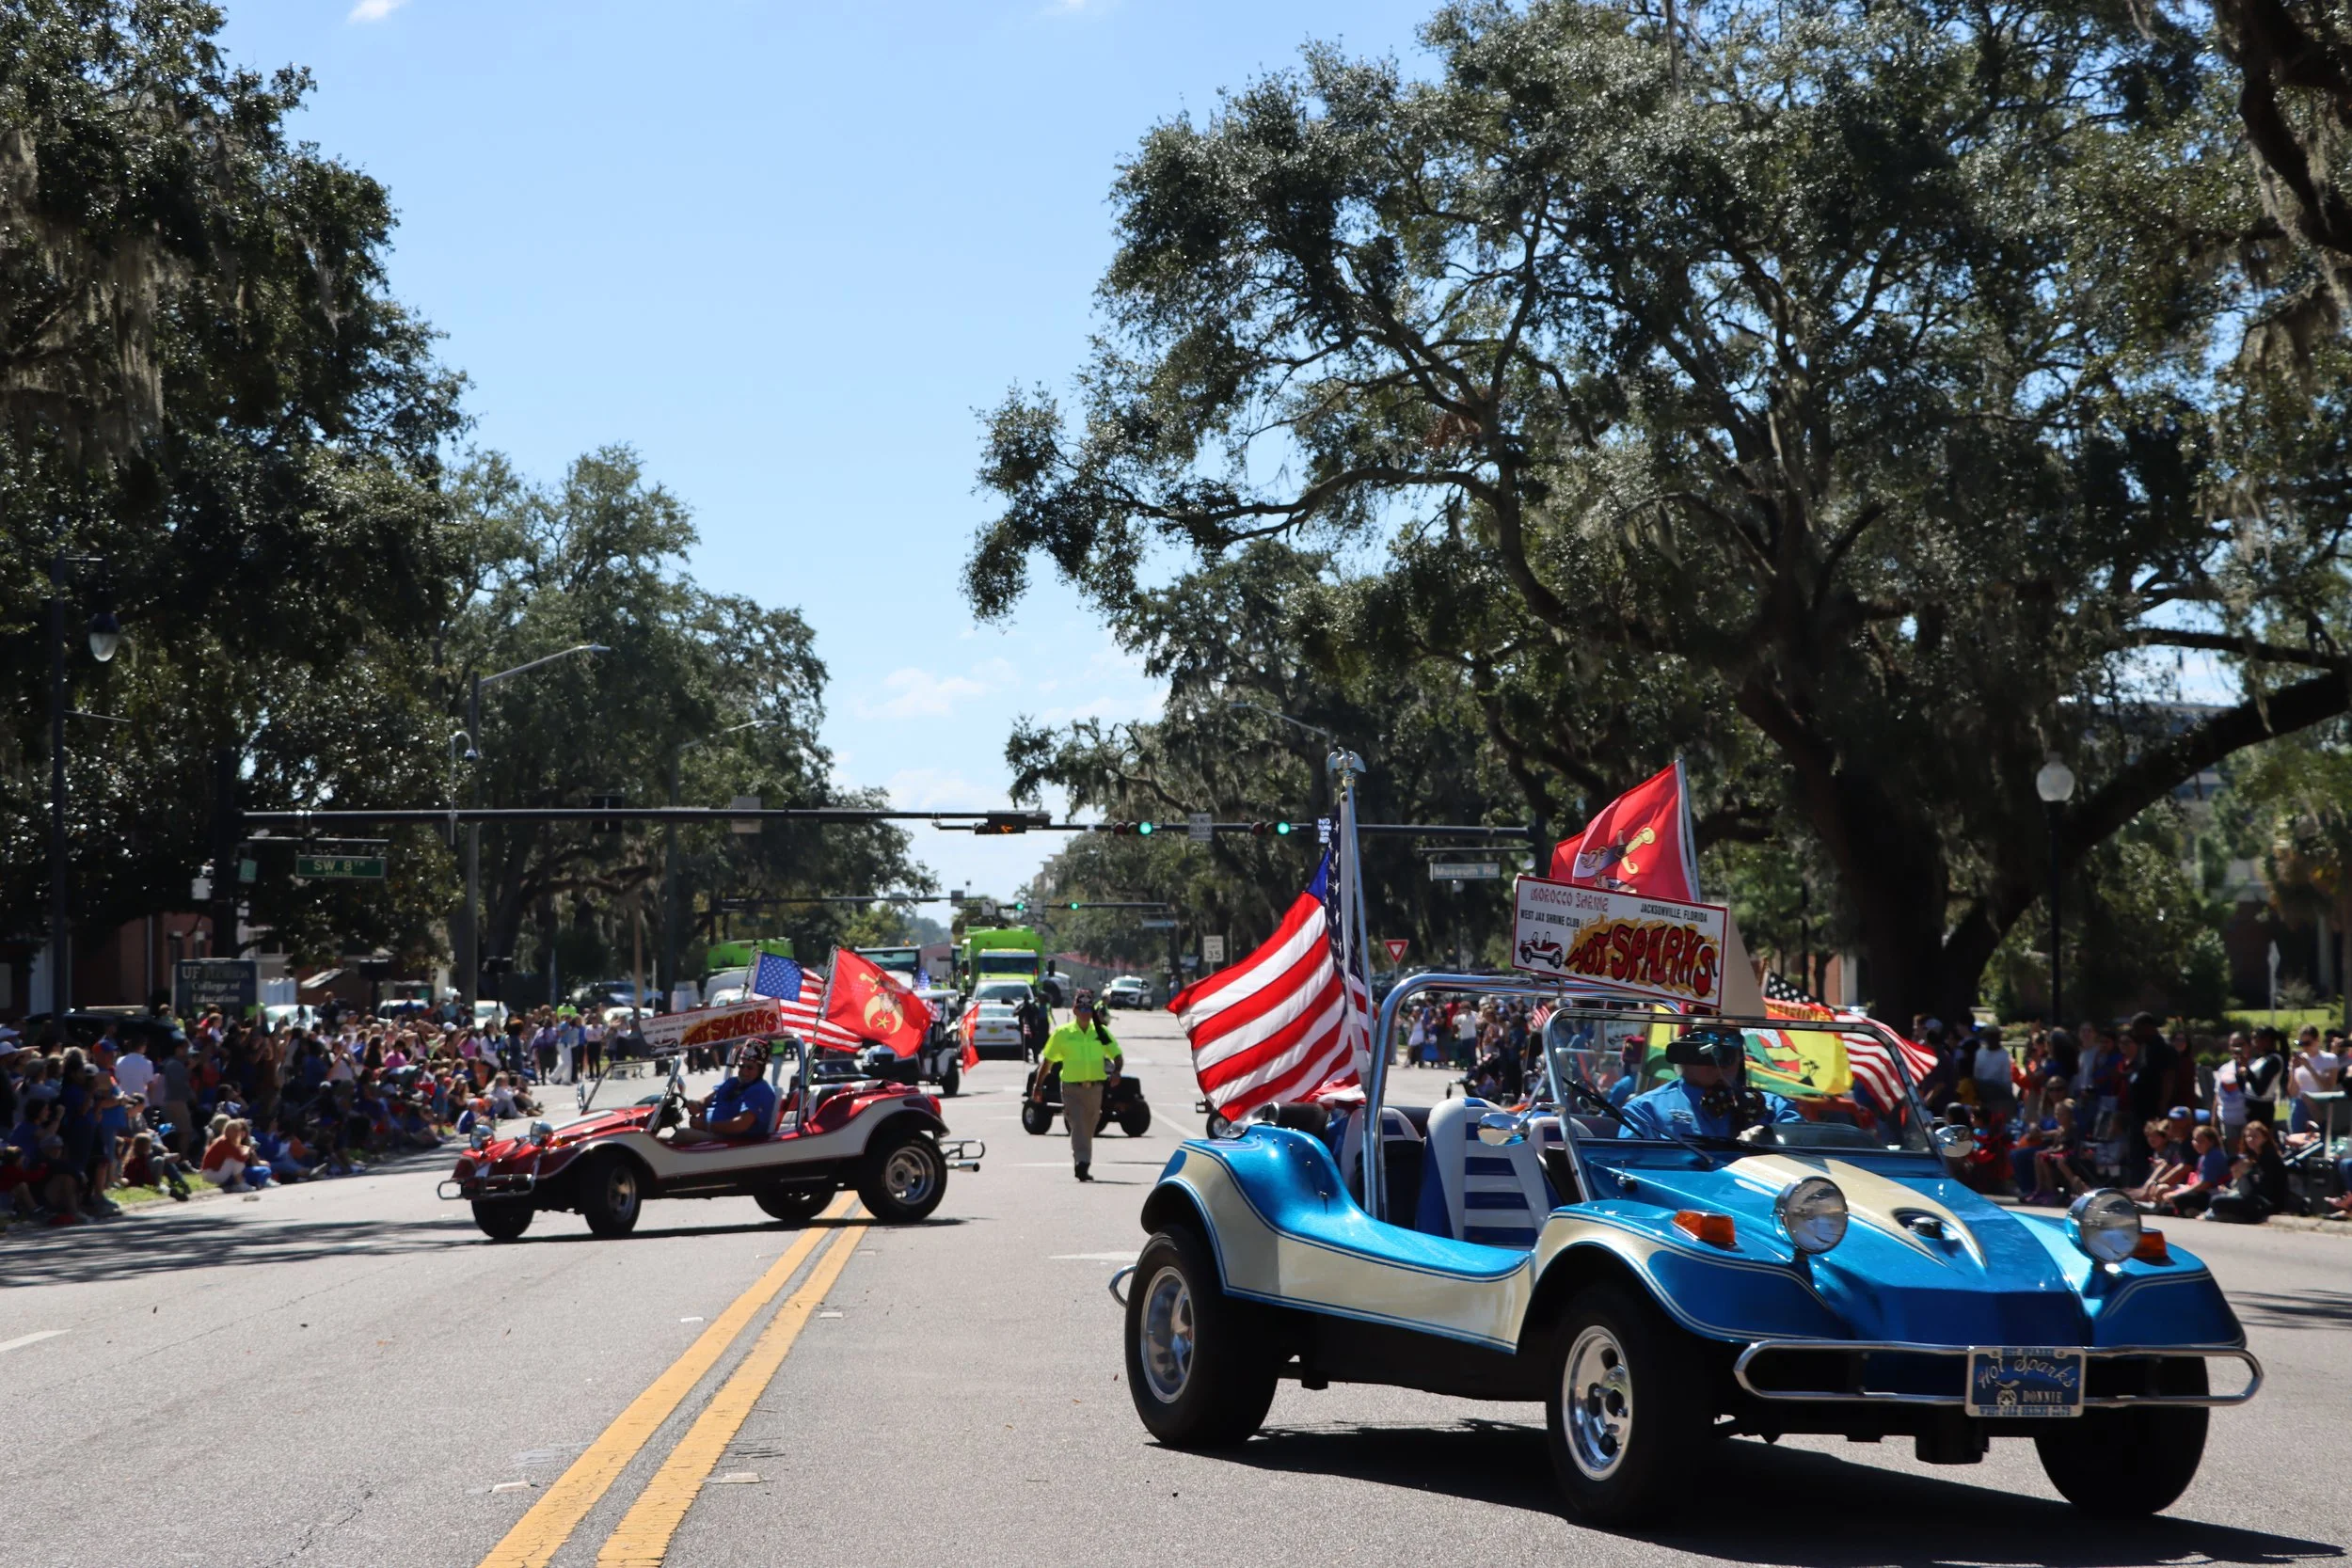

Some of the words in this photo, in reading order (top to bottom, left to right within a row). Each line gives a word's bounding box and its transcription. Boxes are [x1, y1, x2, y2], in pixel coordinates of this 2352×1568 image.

[313, 860, 336, 871] SW
[1530, 887, 1573, 907] MOROCCO
[1520, 910, 1534, 921] WEST
[1534, 911, 1545, 923] JAX
[1546, 913, 1565, 927] SHRINE
[1565, 916, 1580, 928] CLUB
[1640, 903, 1682, 920] JACKSONVILLE,
[1683, 911, 1708, 924] FLORIDA
[1207, 950, 1221, 959] 35
[1565, 930, 1613, 975] HOT
[1611, 923, 1719, 997] SPARKS
[182, 966, 201, 979] UF
[192, 981, 228, 993] College
[192, 993, 240, 1004] Education
[709, 1008, 780, 1041] SPARKS
[2014, 1354, 2076, 1387] Sparks
[2023, 1390, 2063, 1403] DONNIE
